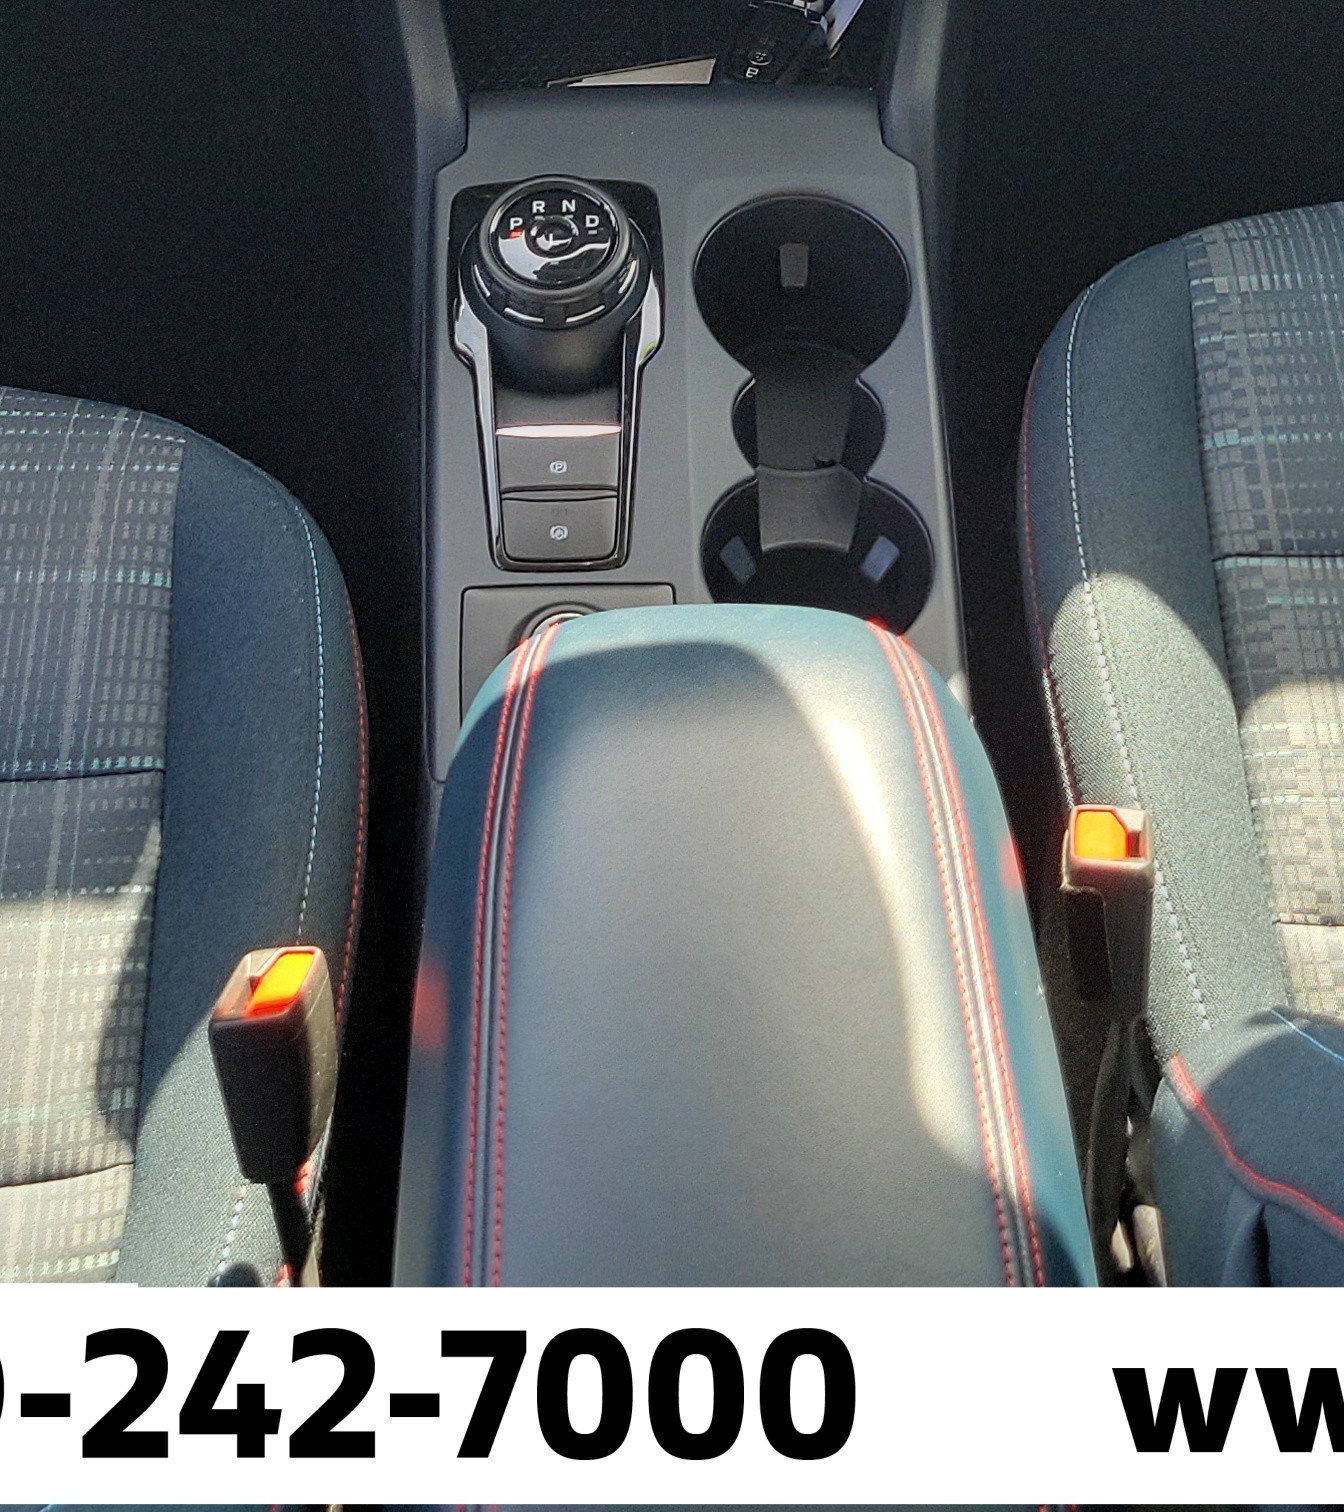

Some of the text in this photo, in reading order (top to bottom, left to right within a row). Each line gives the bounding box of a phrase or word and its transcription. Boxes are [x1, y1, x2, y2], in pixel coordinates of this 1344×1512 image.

[509, 199, 600, 230] P R N D
